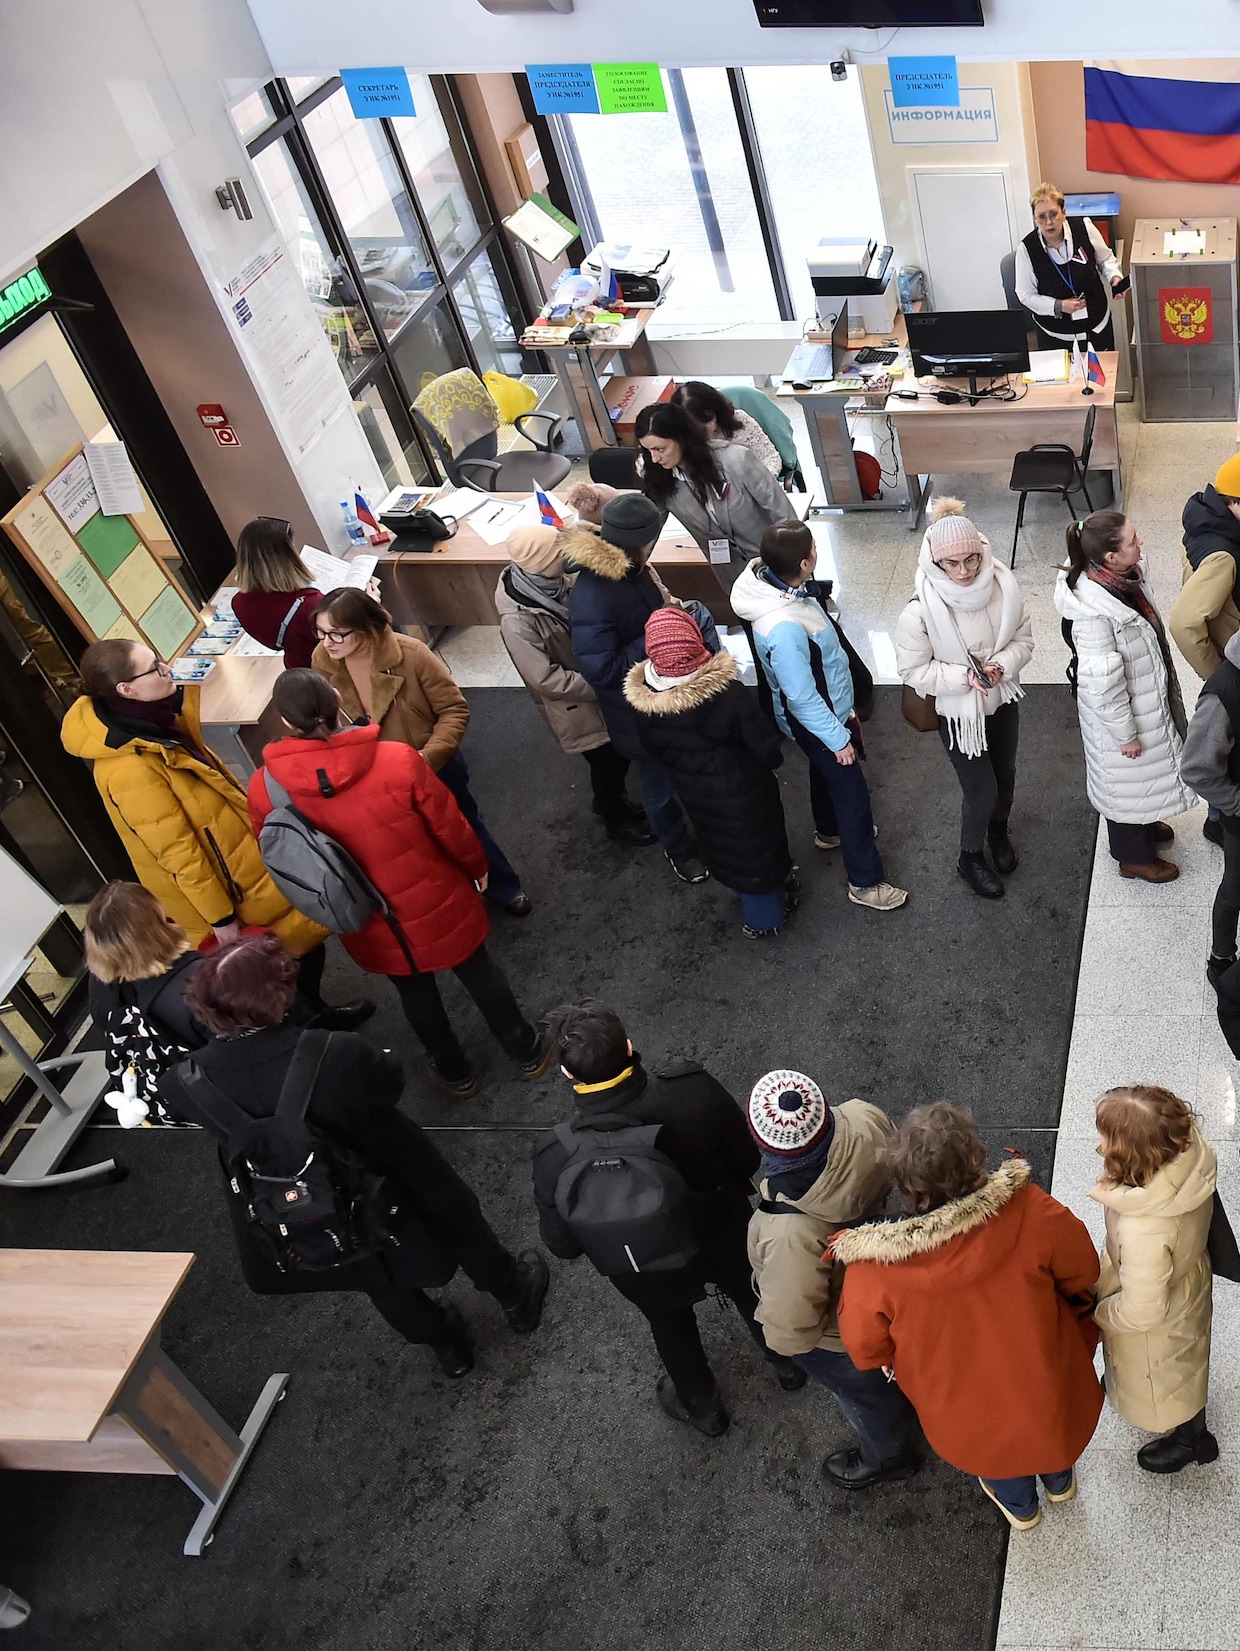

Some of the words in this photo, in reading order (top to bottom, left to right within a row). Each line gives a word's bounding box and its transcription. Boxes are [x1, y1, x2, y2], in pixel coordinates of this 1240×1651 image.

[895, 73, 953, 81] ПРЕДСЕДАТЕЛЬ
[357, 84, 399, 92] СЕКРЕТАРЬ
[891, 109, 992, 121] ИНФОРМАЦИЯ
[912, 317, 938, 326] acer
